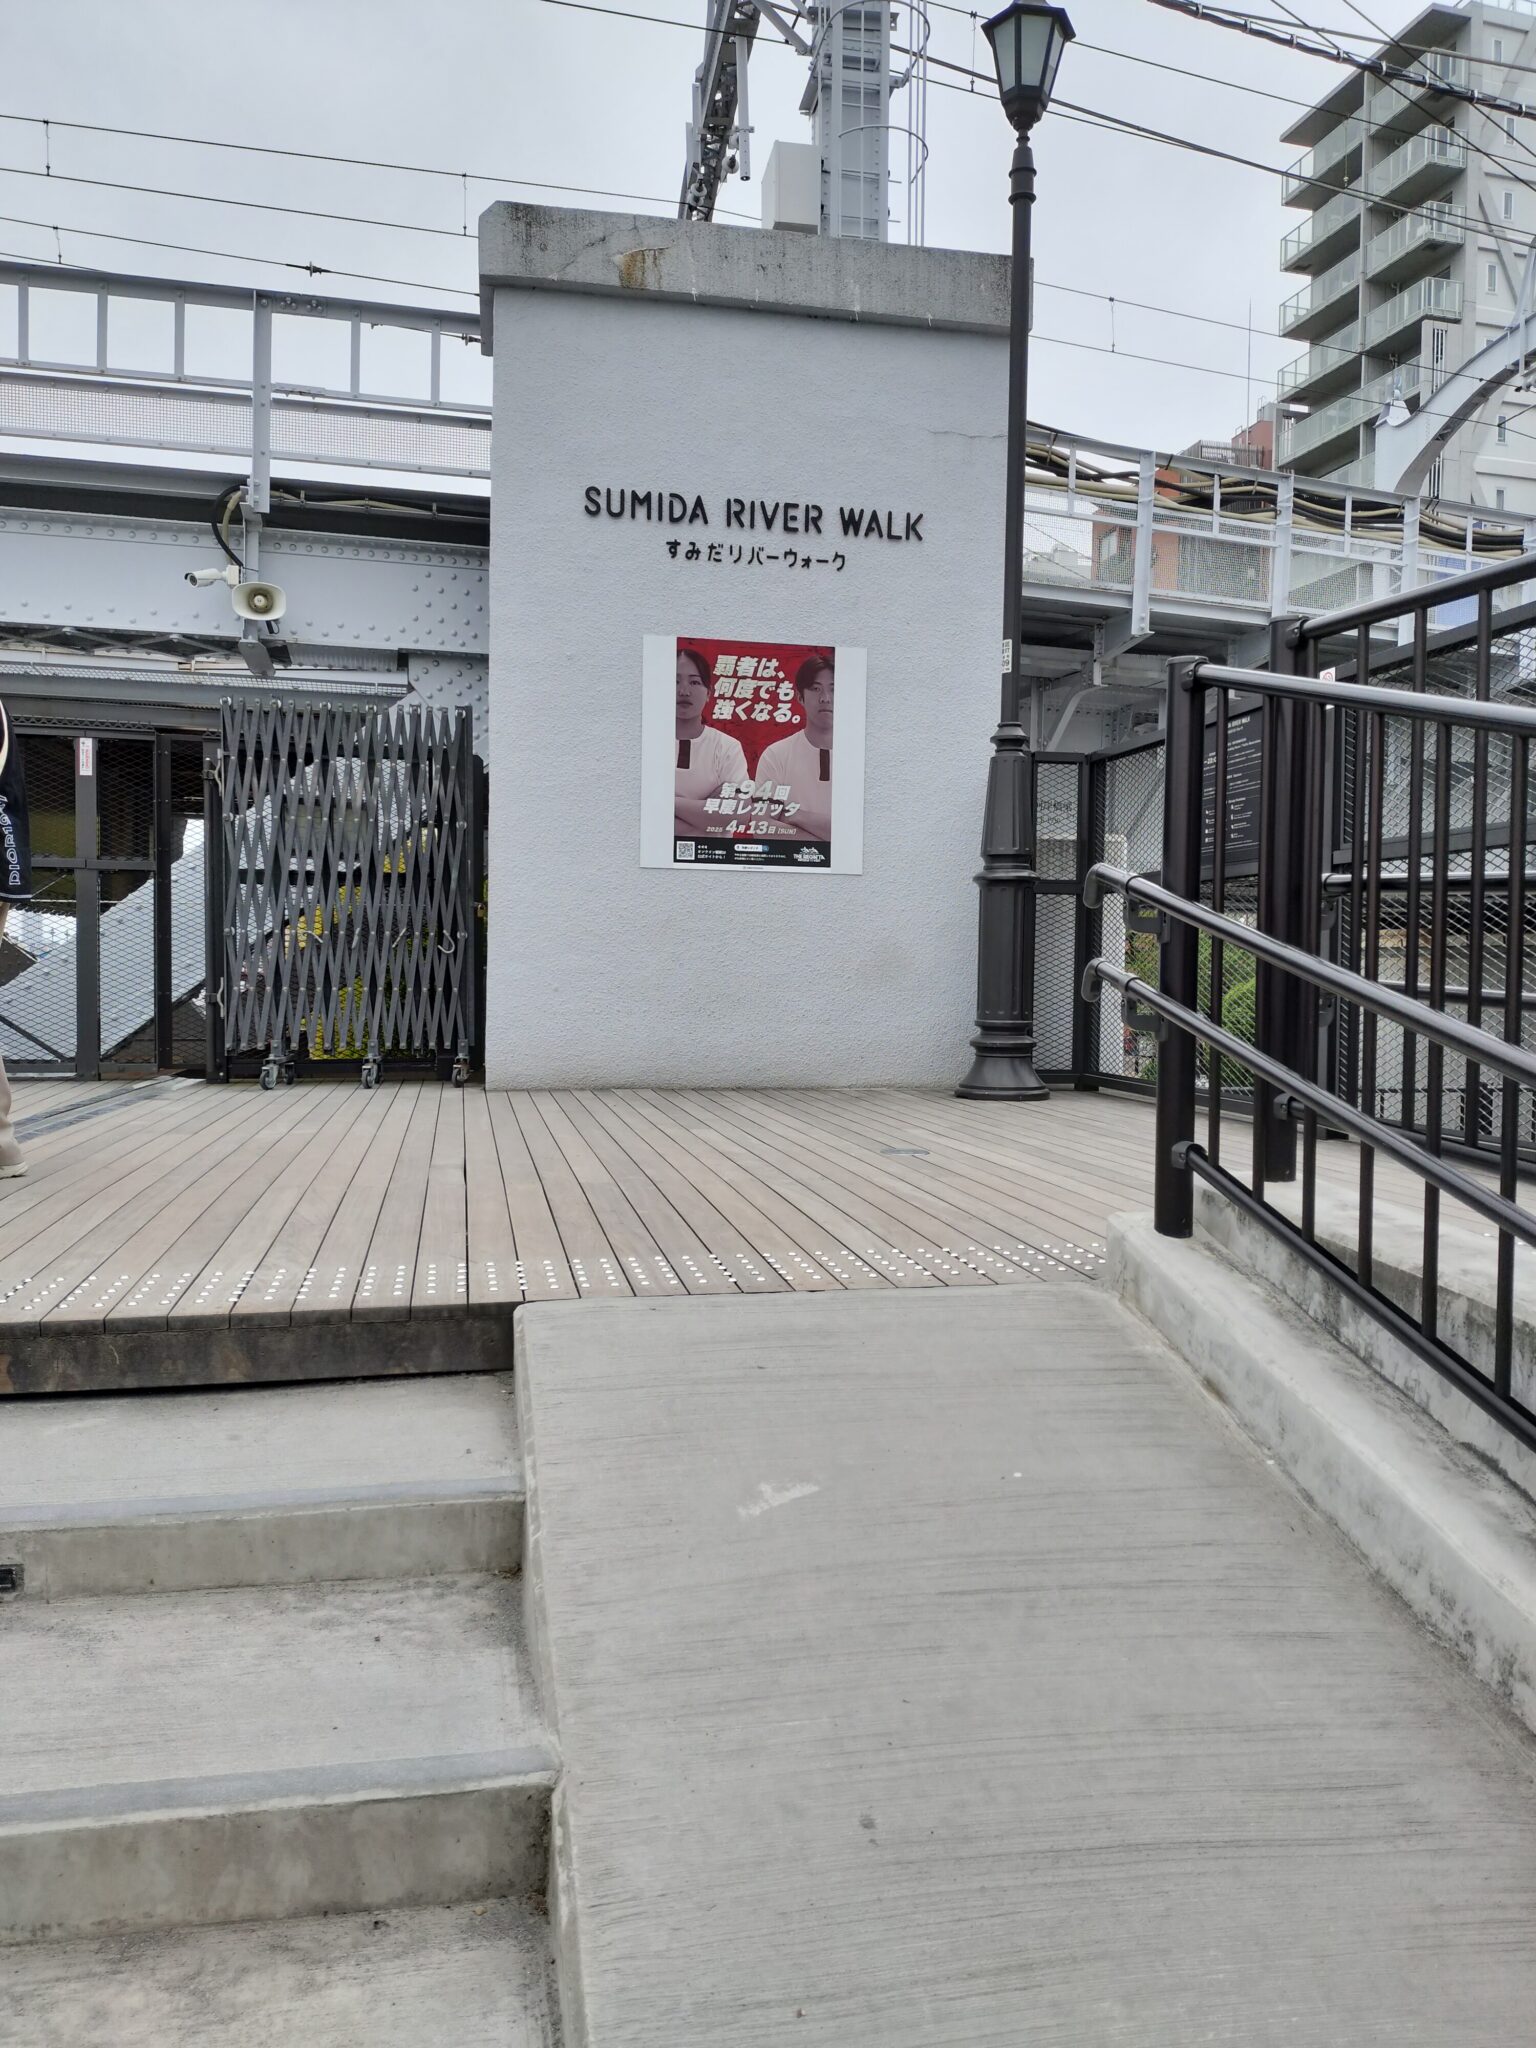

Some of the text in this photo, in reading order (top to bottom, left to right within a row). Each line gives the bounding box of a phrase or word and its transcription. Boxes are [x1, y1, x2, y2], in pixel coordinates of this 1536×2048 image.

[584, 486, 924, 542] SUMIDA RIVER WALK
[666, 538, 846, 572] すみだリバーウォーク
[712, 654, 785, 679] 覇者は、
[713, 676, 795, 701] 何度でも
[712, 698, 801, 724] 強くなる。
[719, 779, 791, 801] 第94回
[703, 798, 800, 817] 早慶レガッタ
[725, 819, 776, 835] 4月13日
